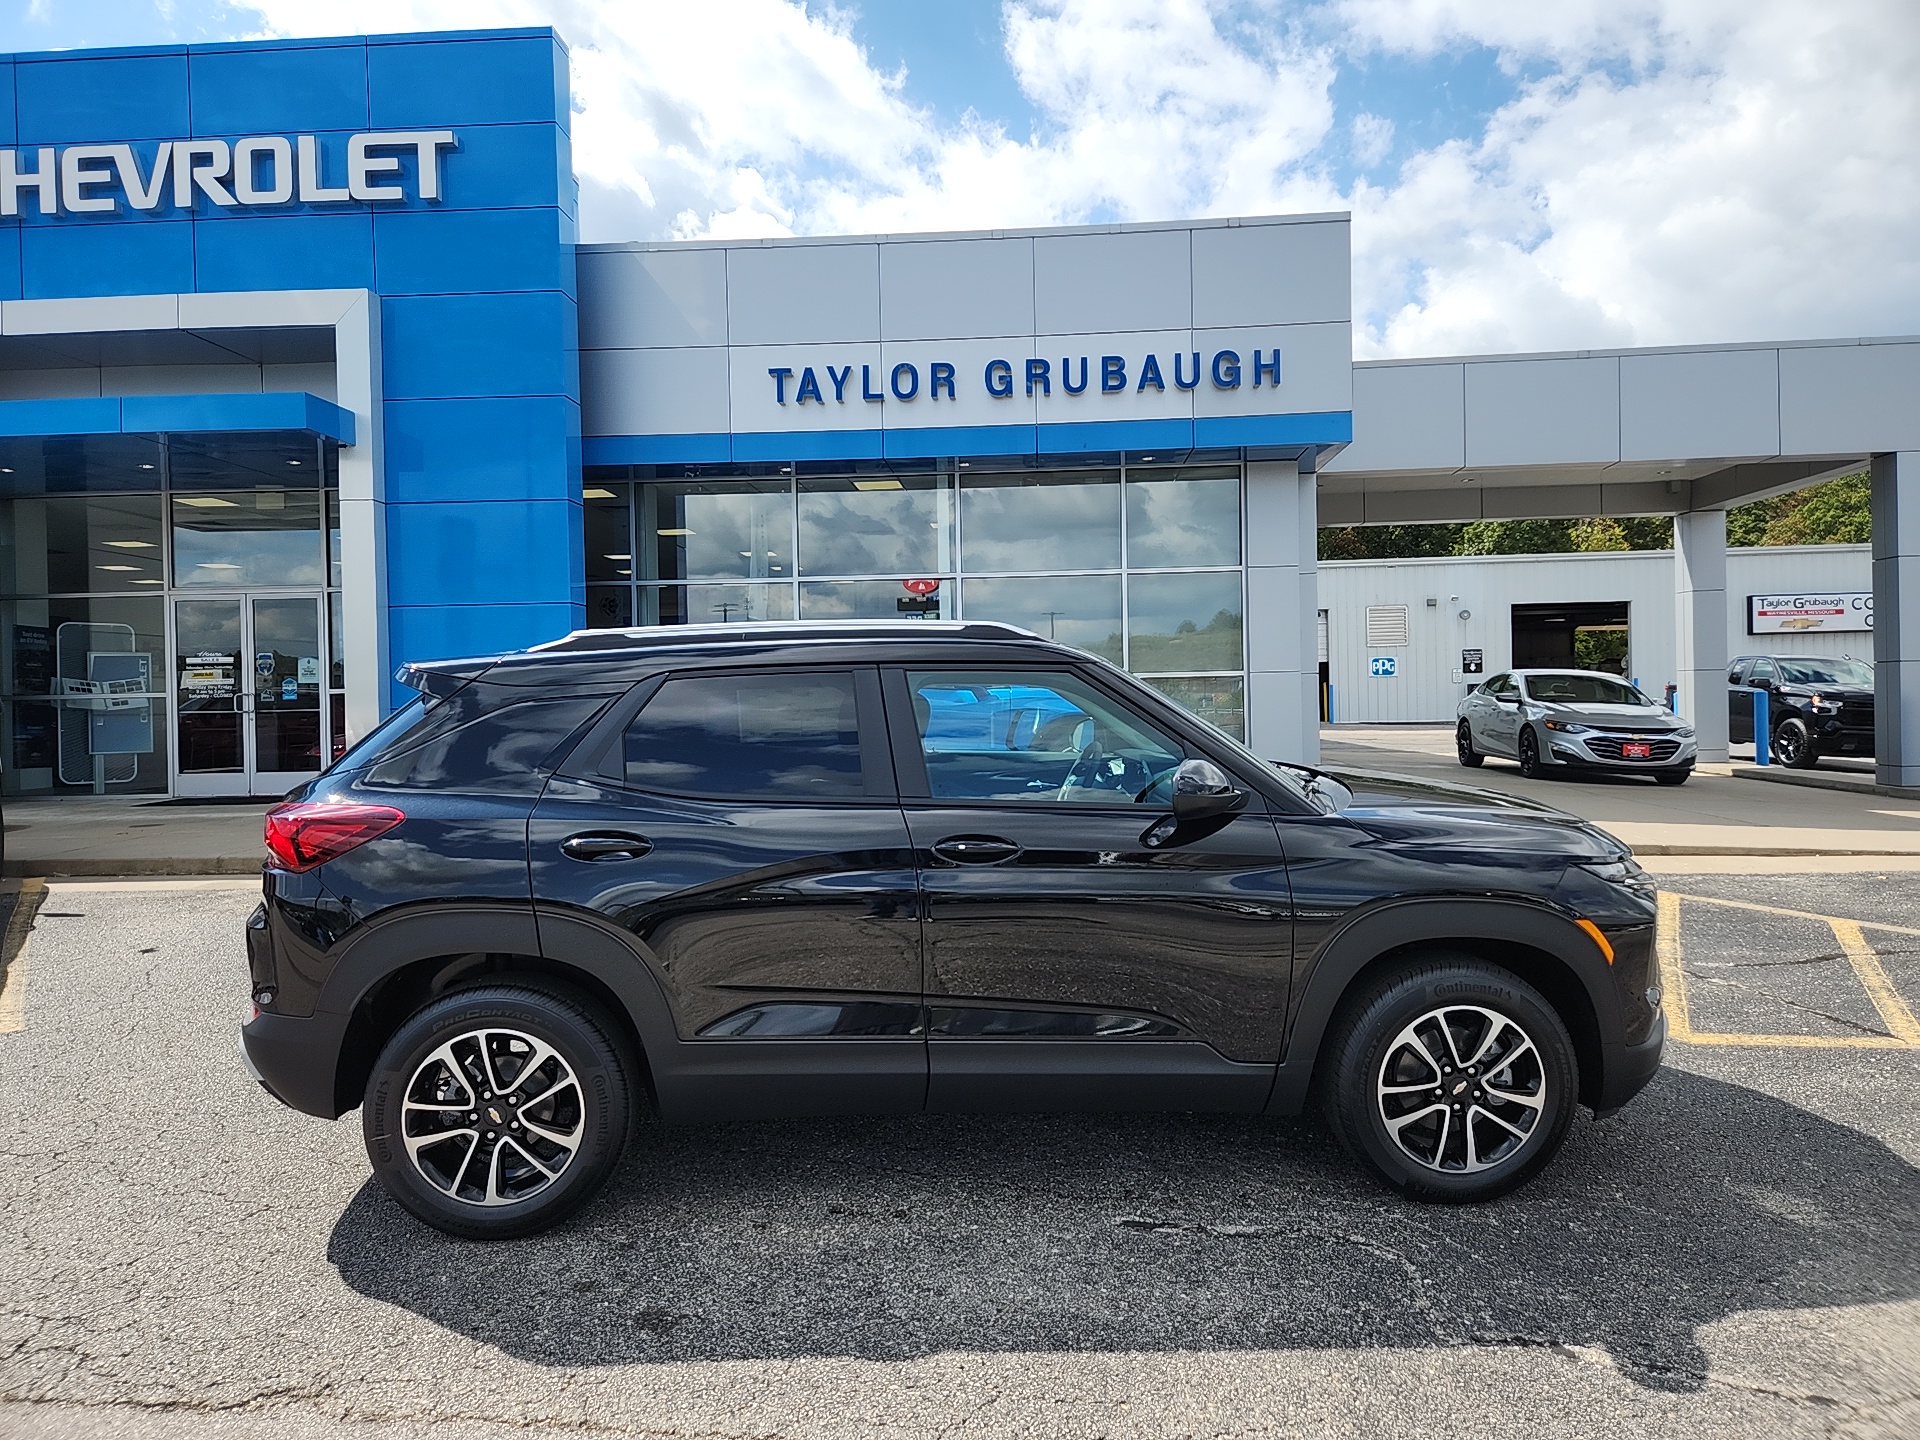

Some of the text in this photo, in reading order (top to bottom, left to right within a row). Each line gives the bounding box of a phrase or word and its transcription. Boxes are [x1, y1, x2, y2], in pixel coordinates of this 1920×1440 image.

[0, 131, 459, 218] HEVROLET
[768, 349, 1282, 406] TAYLOR GRUBAUGH
[1757, 597, 1845, 609] Taylor Grubaugh
[1373, 660, 1395, 674] PPG
[1434, 980, 1503, 998] Continental
[375, 1089, 392, 1163] Continental
[591, 1073, 610, 1146] Continental
